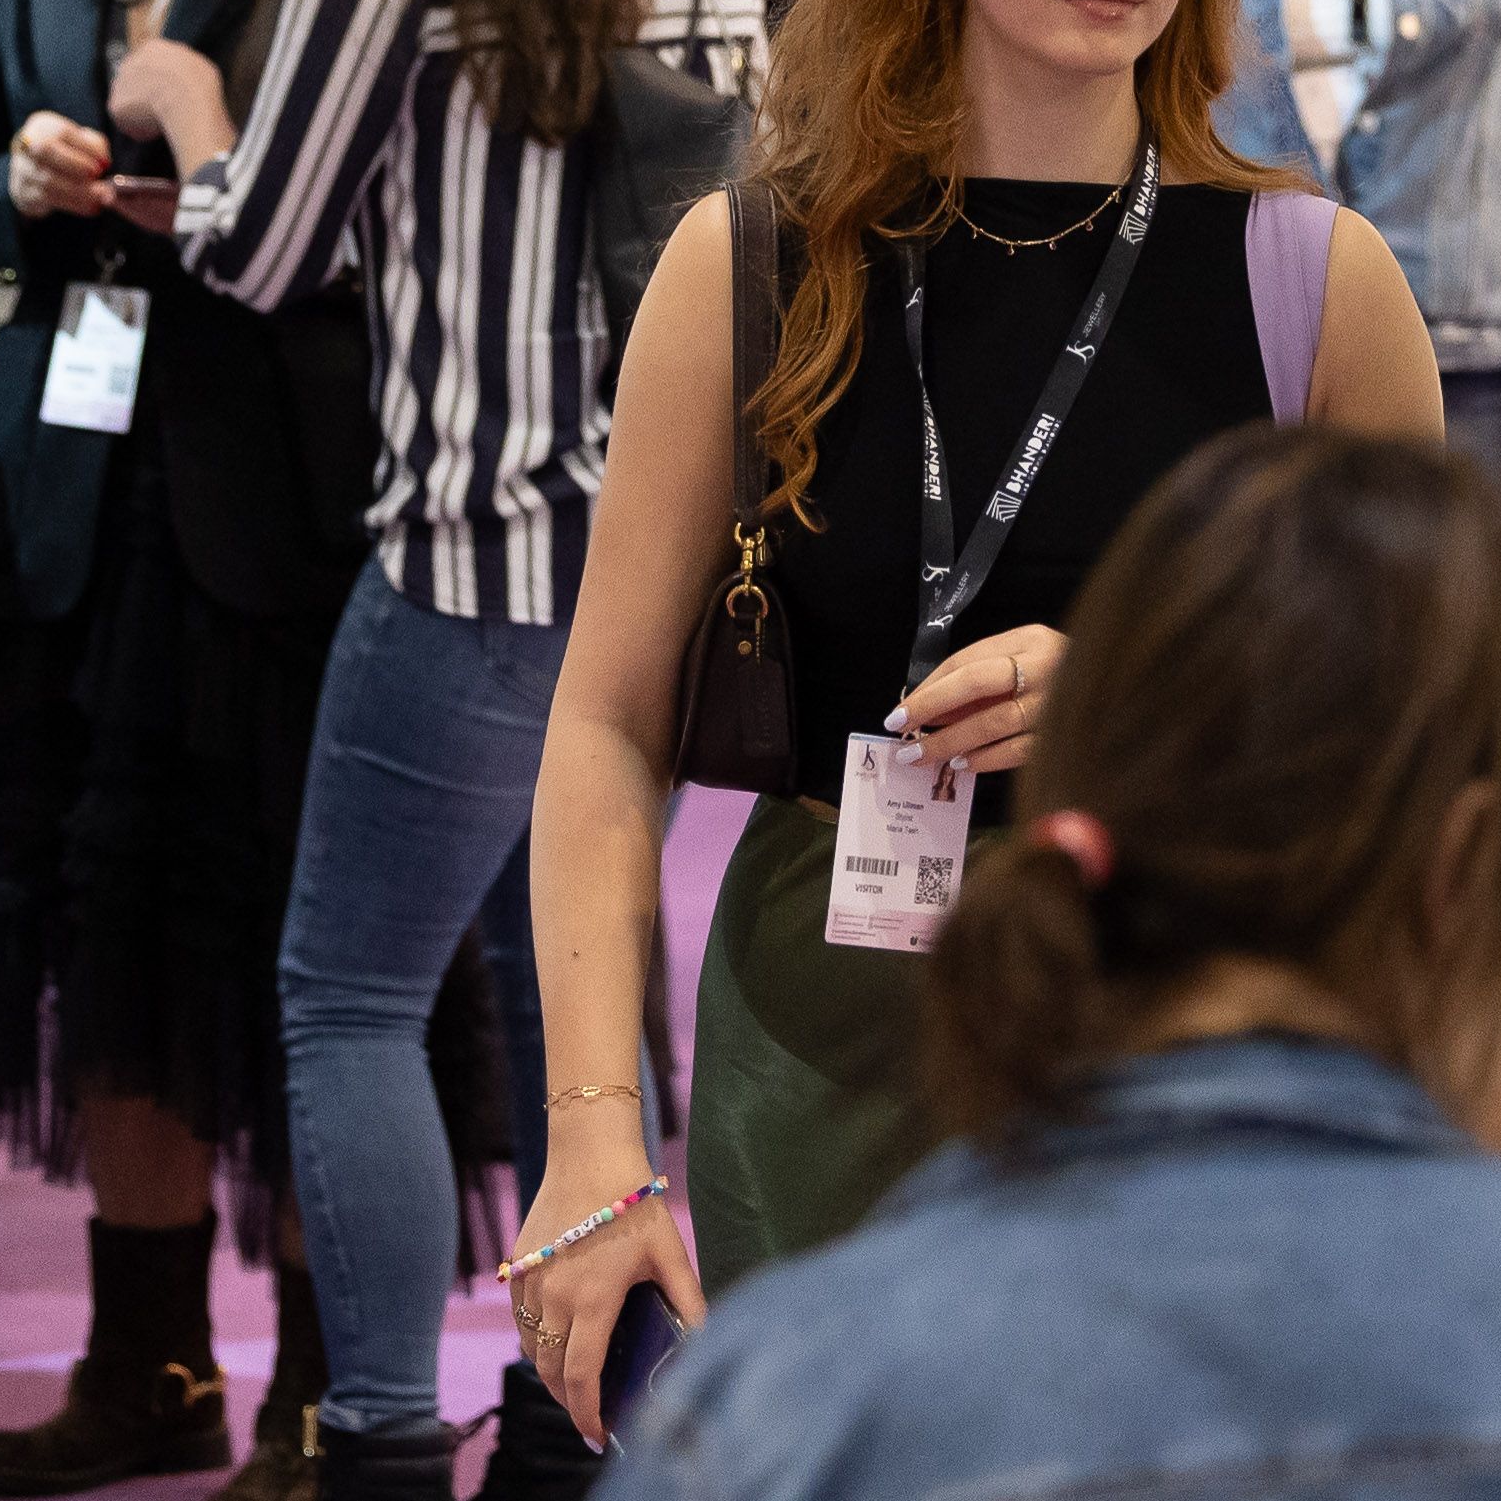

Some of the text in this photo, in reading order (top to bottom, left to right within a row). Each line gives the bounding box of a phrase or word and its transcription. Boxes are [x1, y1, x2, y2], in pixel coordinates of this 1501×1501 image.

[1133, 143, 1156, 217] BHANDERI
[1082, 291, 1106, 338] JEWELLERY
[1005, 413, 1055, 493] BHANDERI
[855, 883, 883, 895] VISITOR
[564, 1214, 599, 1243] LOVE
